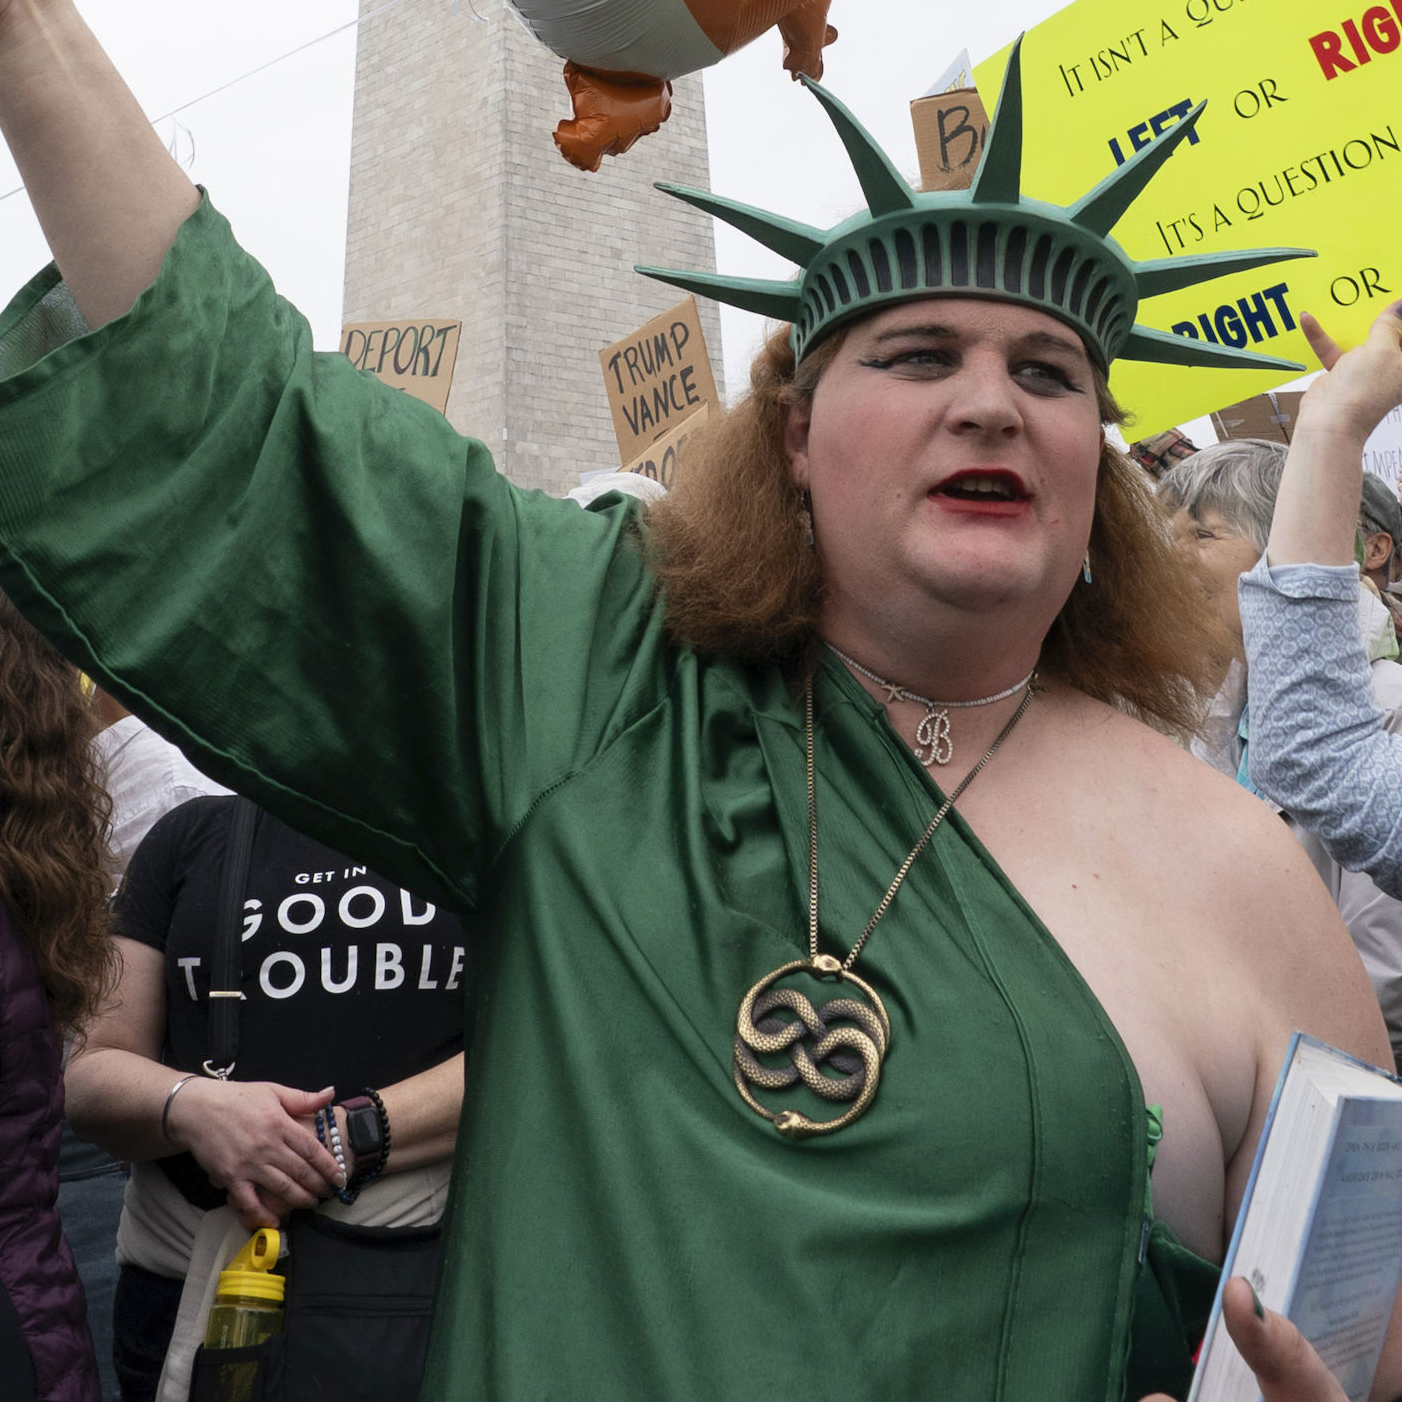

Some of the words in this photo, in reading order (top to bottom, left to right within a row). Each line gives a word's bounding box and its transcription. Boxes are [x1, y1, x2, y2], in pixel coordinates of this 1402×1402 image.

[1089, 29, 1148, 82] ISN'T
[1161, 19, 1179, 47] A
[1234, 78, 1289, 119] OR
[1214, 203, 1233, 232] A
[1236, 126, 1401, 220] QUESTION
[1330, 267, 1393, 306] OR
[608, 322, 689, 394] TRUMP
[622, 365, 700, 436] VANCE
[295, 871, 335, 884] GET
[344, 866, 367, 879] IN
[178, 943, 465, 1001] TOUBLE
